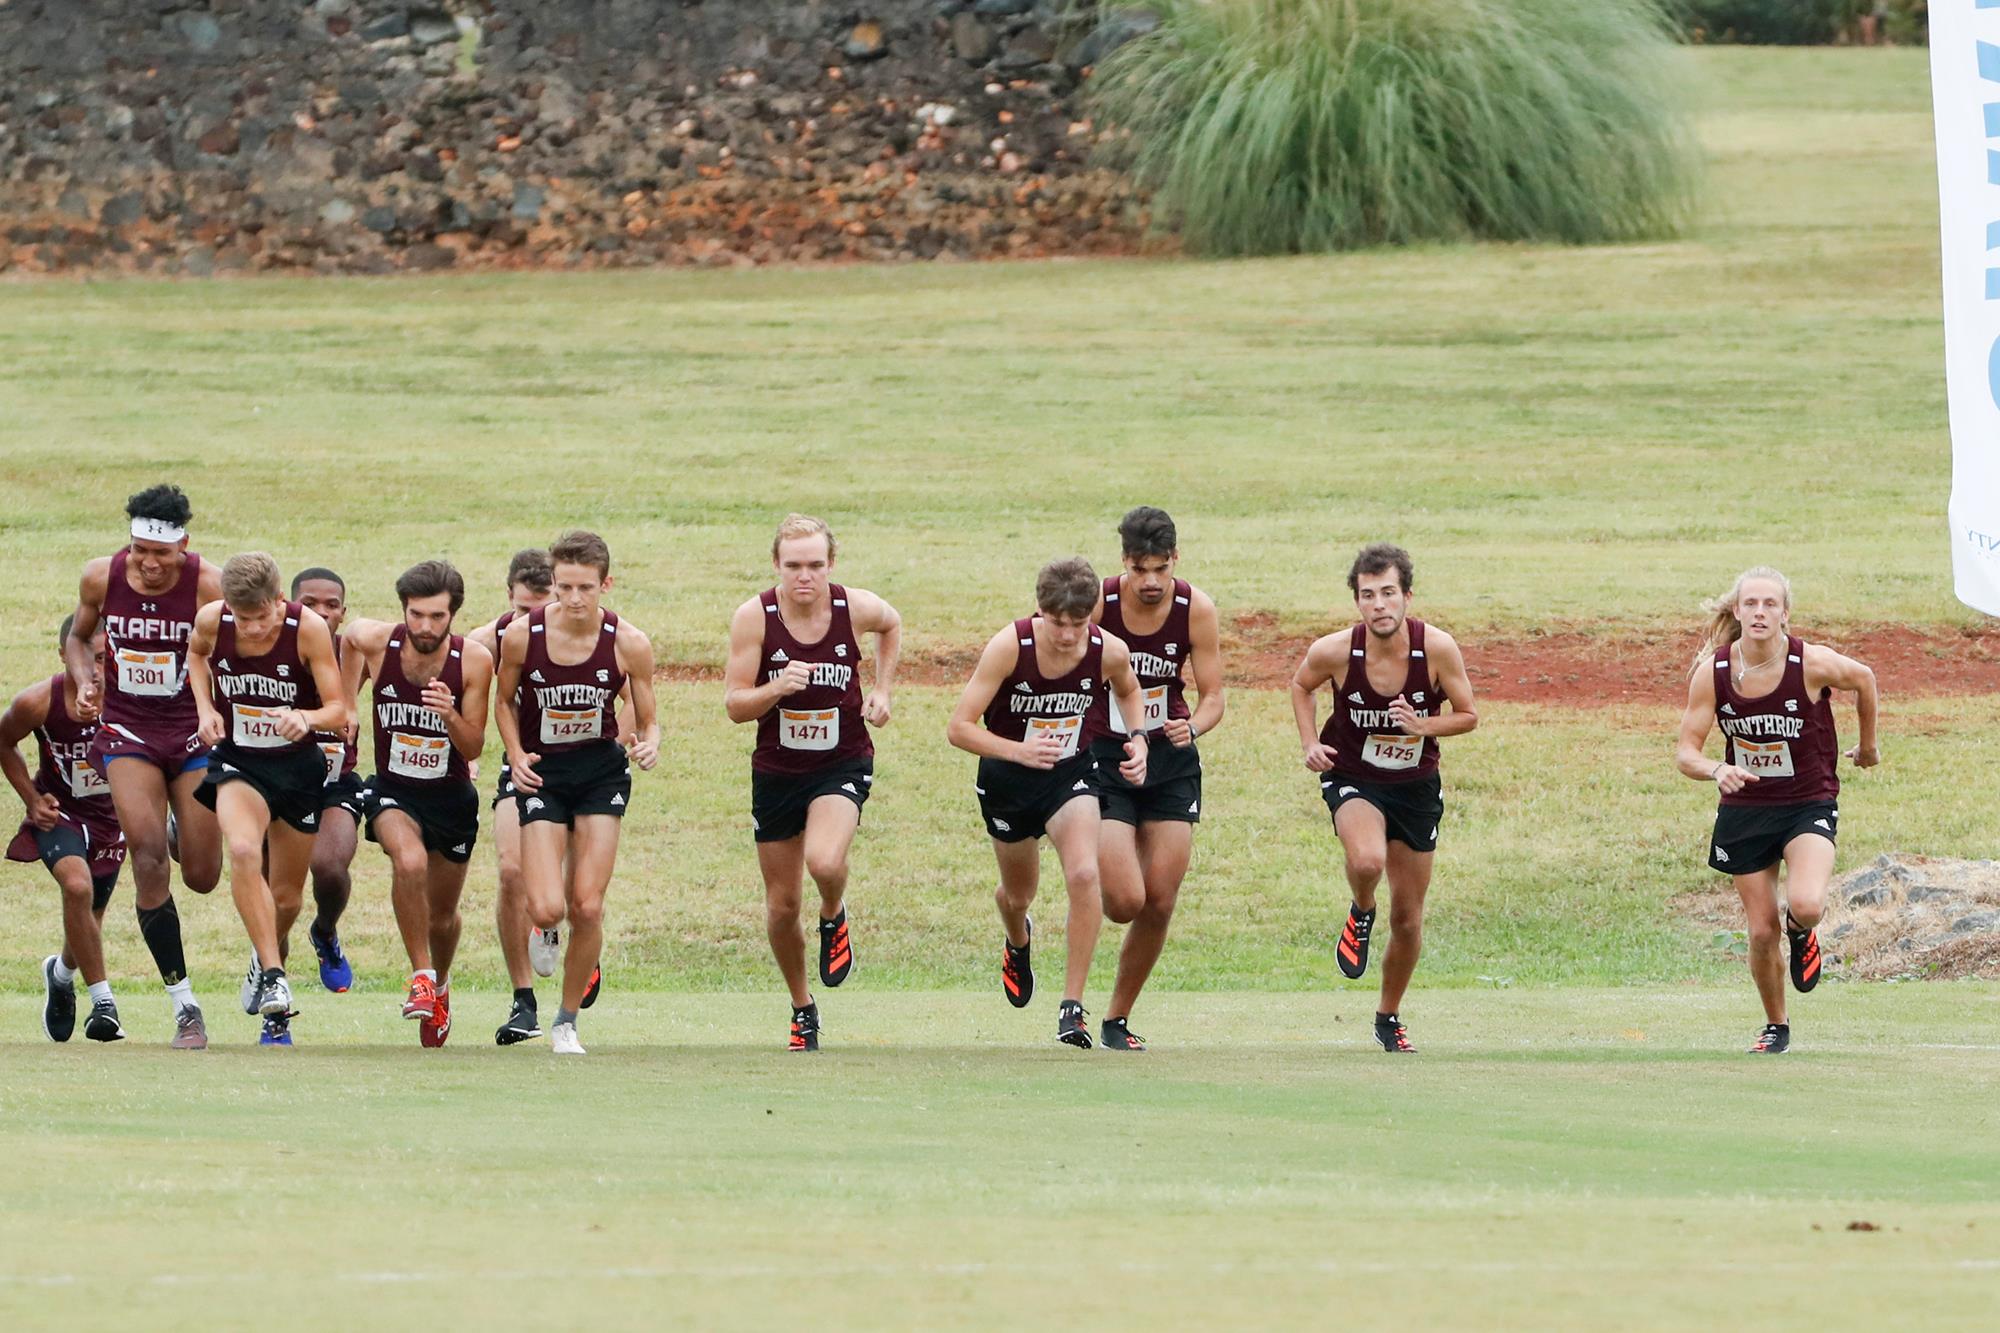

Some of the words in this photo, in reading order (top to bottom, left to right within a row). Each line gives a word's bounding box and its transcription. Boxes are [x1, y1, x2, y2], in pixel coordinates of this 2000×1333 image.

[106, 615, 192, 642] CLAFLIN
[127, 668, 164, 685] 1301
[218, 674, 297, 702] WINTHROP
[1010, 693, 1093, 715] WINTHROP
[377, 703, 448, 733] WINTHR
[1720, 714, 1804, 738] WINTHROP
[551, 722, 592, 735] 1472
[789, 725, 828, 739] 1471
[400, 750, 440, 768] 1469
[1374, 744, 1415, 760] 1475
[1743, 754, 1783, 767] 1474
